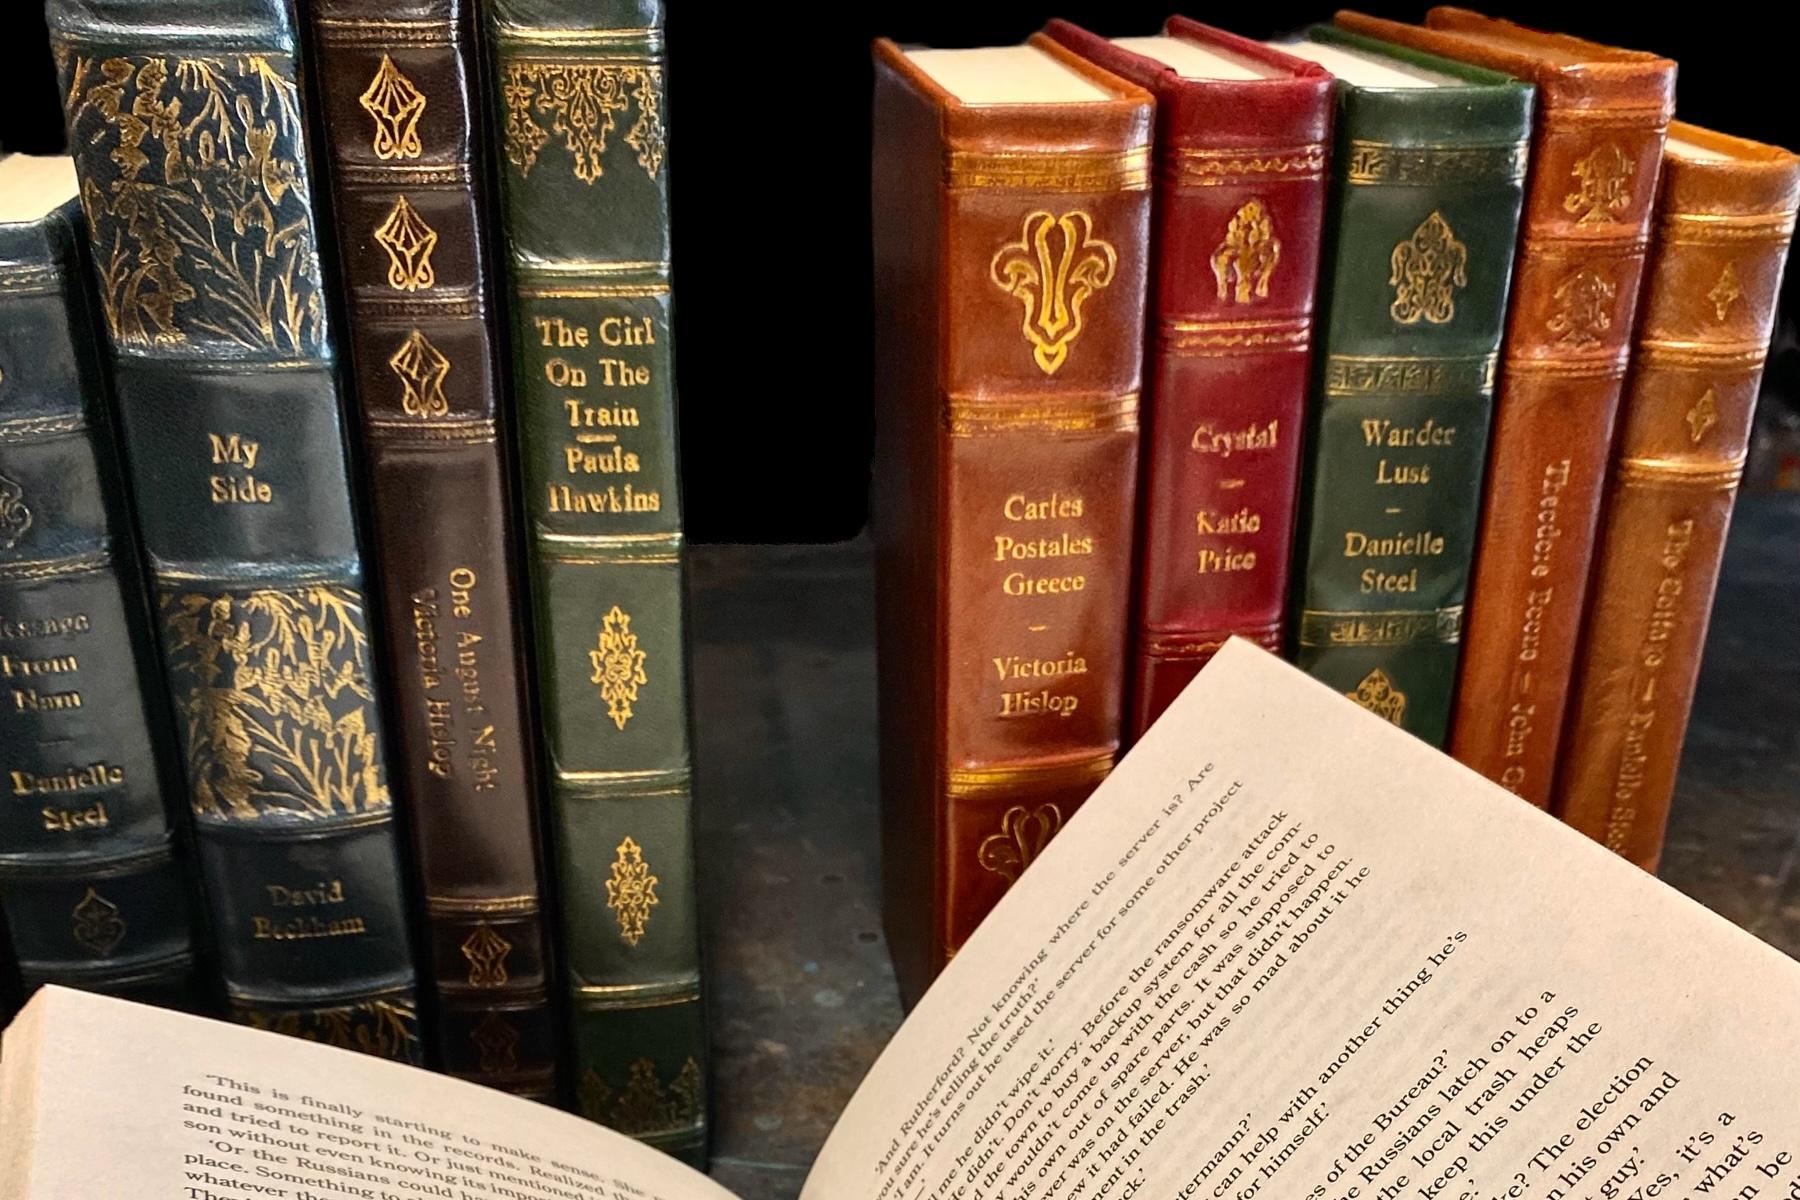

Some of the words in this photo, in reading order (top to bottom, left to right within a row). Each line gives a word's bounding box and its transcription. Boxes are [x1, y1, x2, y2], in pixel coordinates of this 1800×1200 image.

[534, 316, 589, 348] The
[599, 316, 655, 347] Girl
[545, 357, 587, 387] On
[599, 358, 650, 387] The
[564, 399, 640, 427] Train
[1361, 417, 1456, 448] Wander
[208, 432, 259, 469] My
[565, 445, 640, 474] Paula
[1375, 459, 1430, 485] Lust
[210, 476, 273, 503] Side
[547, 482, 661, 513] Hawkins
[1003, 492, 1084, 521] Cartes
[1196, 507, 1261, 535] Katie
[994, 533, 1094, 561] Postales
[1344, 531, 1445, 558] Danielle
[1197, 547, 1257, 574] Price
[450, 567, 477, 618] One
[1002, 572, 1086, 596] Greece
[1360, 569, 1418, 595] Steel
[992, 650, 1088, 681] Victoria
[999, 690, 1078, 717] Hislop
[10, 761, 123, 796] Danielle
[900, 1046, 965, 1137] Rutherford?
[966, 1015, 992, 1045] Not
[991, 948, 1048, 1013] knowing
[1048, 900, 1089, 944] where
[1091, 871, 1115, 896] the
[1118, 819, 1160, 867] server
[1161, 793, 1183, 817] is?
[1187, 762, 1214, 792] Are
[271, 1088, 289, 1101] is
[300, 1095, 363, 1119] finally
[374, 1114, 452, 1141] starting
[461, 1134, 481, 1146] to
[490, 1143, 541, 1162] make
